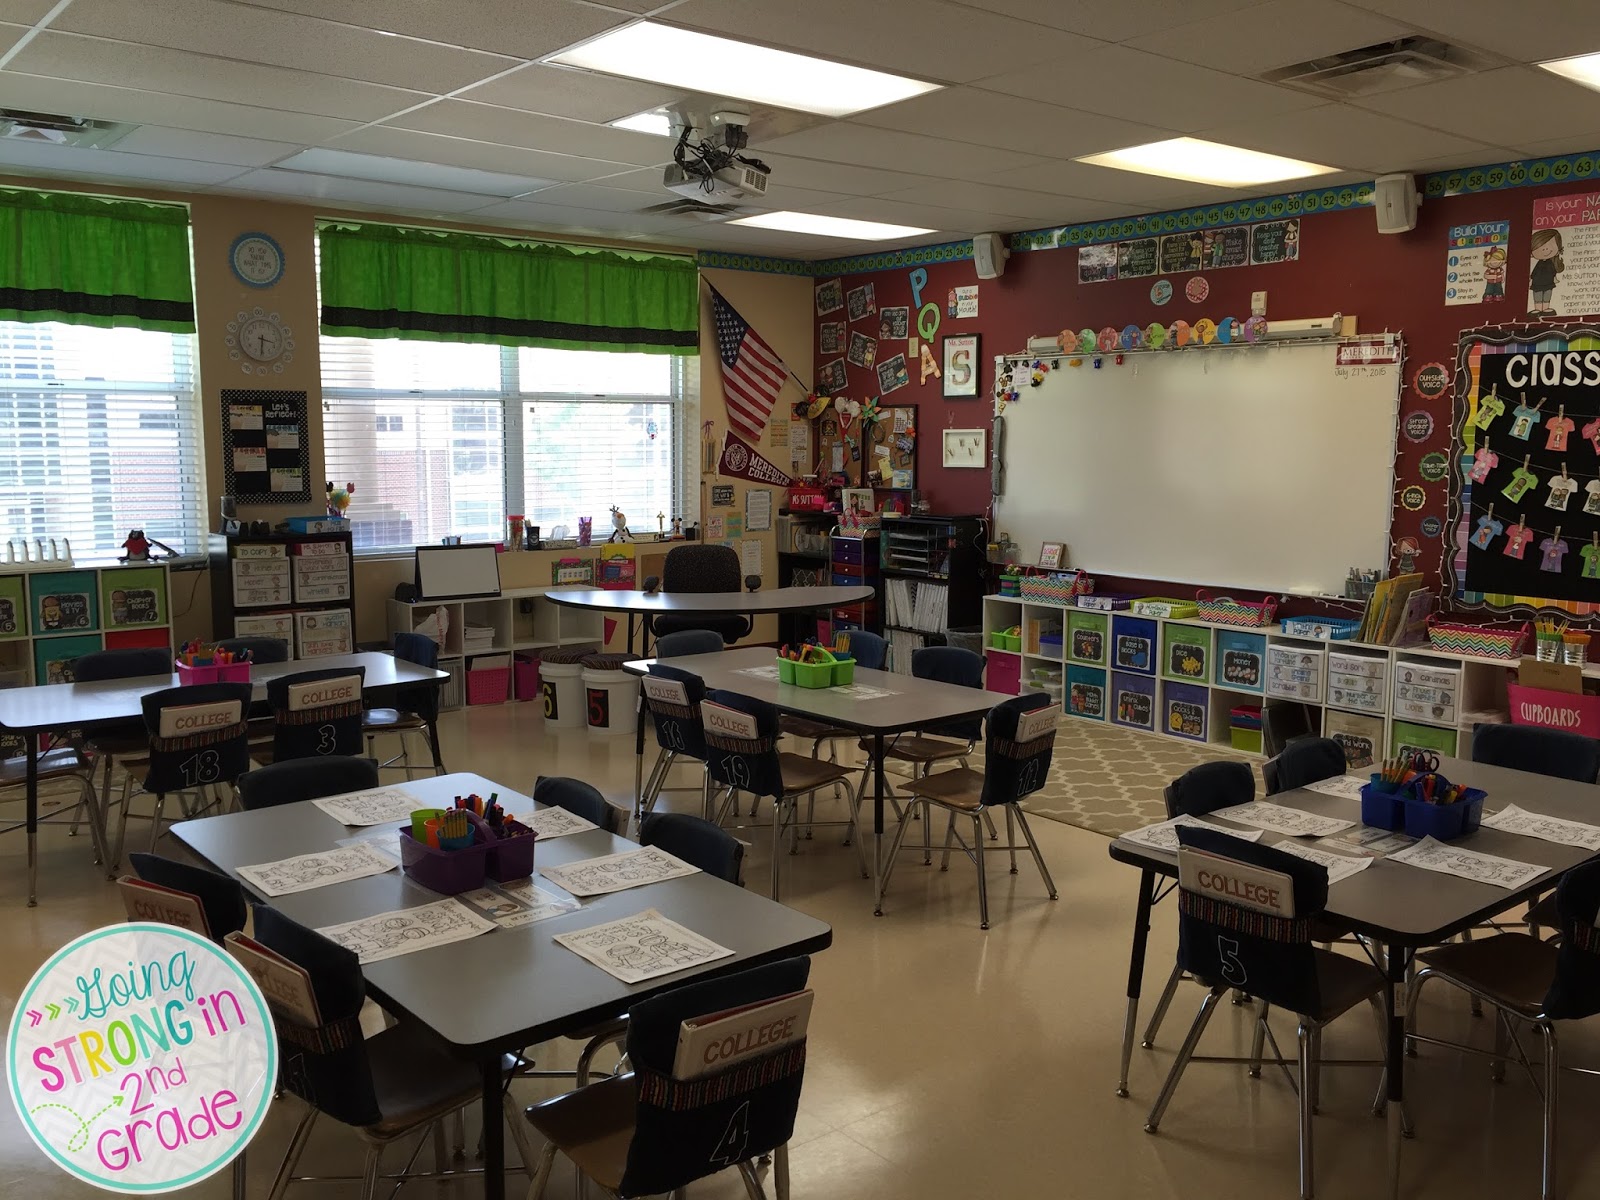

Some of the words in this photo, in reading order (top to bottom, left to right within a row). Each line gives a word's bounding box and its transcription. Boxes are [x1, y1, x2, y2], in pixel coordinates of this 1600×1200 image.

[1429, 181, 1442, 192] 56
[1449, 179, 1462, 189] 57
[1469, 175, 1482, 186] 58
[1490, 172, 1503, 183] 59
[1510, 169, 1525, 181] 60
[1534, 167, 1544, 178] 61
[1554, 164, 1568, 175] 62
[1576, 161, 1591, 172] 63
[1024, 238, 1031, 246] 31
[1036, 236, 1044, 244] 32
[1071, 232, 1079, 240] 35
[1084, 230, 1093, 238] 36
[1098, 229, 1106, 237] 37
[1111, 227, 1119, 235] 38
[1123, 225, 1132, 233] 39
[1137, 222, 1147, 231] 40
[1152, 221, 1160, 230] 41
[1165, 219, 1175, 228] 42
[1179, 216, 1189, 226] 43
[1193, 214, 1204, 223] 44
[1208, 212, 1219, 221] 45
[1224, 210, 1235, 219] 46
[1239, 207, 1250, 217] 47
[1255, 204, 1266, 214] 48
[1272, 202, 1283, 212] 49
[1288, 200, 1299, 210] 50
[1307, 198, 1316, 208] 51
[1322, 195, 1334, 205] 52
[1341, 193, 1352, 204] 53
[1536, 217, 1549, 226] on
[1550, 214, 1576, 226] your
[1556, 199, 1582, 212] your
[1454, 225, 1477, 237] Build
[1479, 224, 1504, 235] Your
[909, 267, 928, 309] P
[917, 302, 941, 344] Q
[920, 344, 942, 386] A
[952, 350, 971, 385] S
[1335, 368, 1348, 380] July
[1370, 367, 1387, 377] 2015
[748, 467, 788, 486] COLLEGE
[749, 453, 790, 484] MEREDITH
[250, 548, 268, 556] COPY
[302, 686, 353, 705] COLLEGE
[542, 684, 553, 717] 6
[590, 690, 604, 726] 5
[650, 685, 679, 701] COLLEGE
[175, 712, 233, 730] COLLEGE
[710, 713, 750, 735] COLLEGE
[1028, 716, 1056, 736] COLLEGE
[1521, 702, 1581, 728] CLIPBOARDS
[316, 724, 337, 755] 3
[179, 750, 220, 787] 18
[721, 755, 751, 788] 19
[1199, 871, 1281, 908] COLLEGE
[134, 902, 191, 923] COLLEGE
[1218, 935, 1248, 985] 5
[704, 1015, 799, 1065] COLLEGE
[709, 1100, 750, 1165] 4
